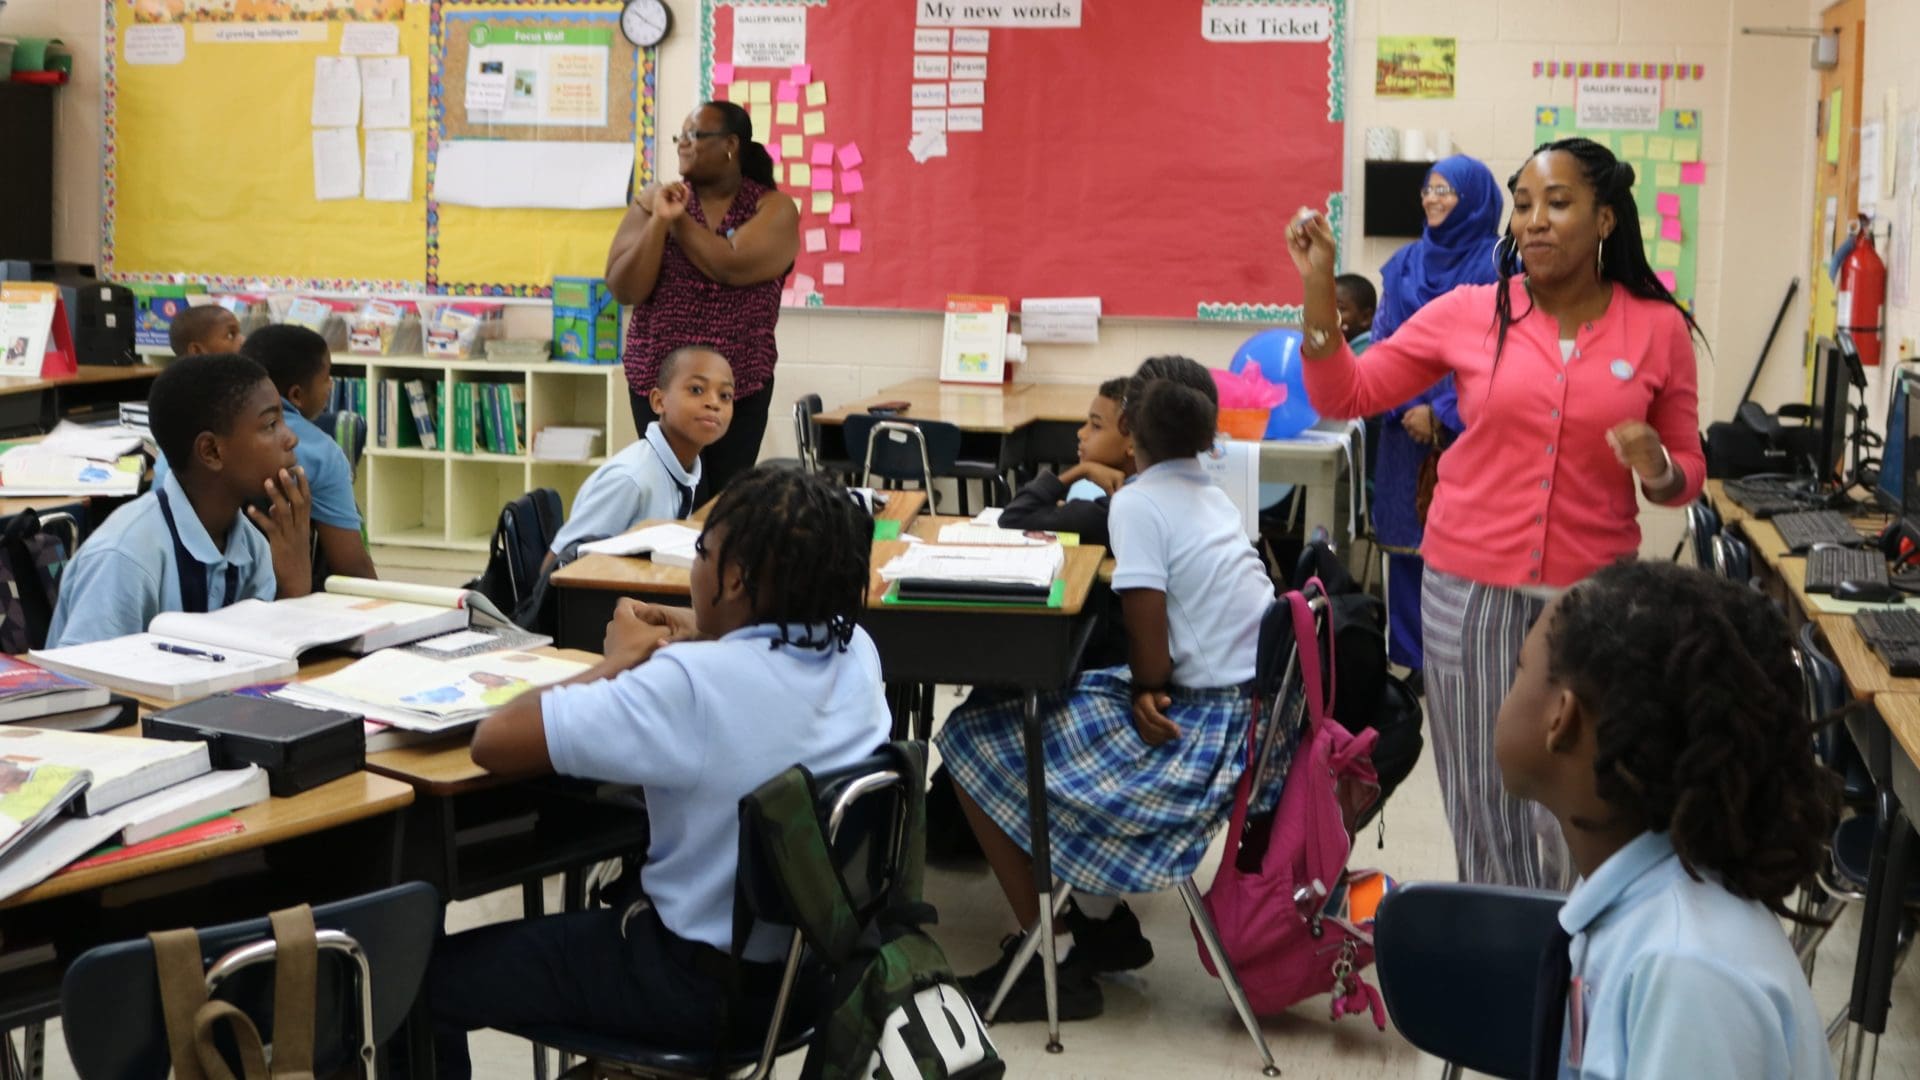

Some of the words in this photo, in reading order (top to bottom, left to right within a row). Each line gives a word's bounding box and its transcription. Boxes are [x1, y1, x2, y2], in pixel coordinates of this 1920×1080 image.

[738, 15, 770, 24] GALLERY
[774, 15, 795, 24] WALK
[925, 2, 954, 24] My
[964, 6, 1002, 19] new
[1013, 2, 1071, 19] words
[1210, 18, 1246, 35] Exit
[1257, 18, 1319, 35] Ticket
[515, 30, 541, 42] Focus
[544, 30, 565, 42] Wall
[1384, 75, 1417, 89] Grade
[1583, 85, 1620, 94] GALLERY
[1624, 85, 1649, 94] WALK
